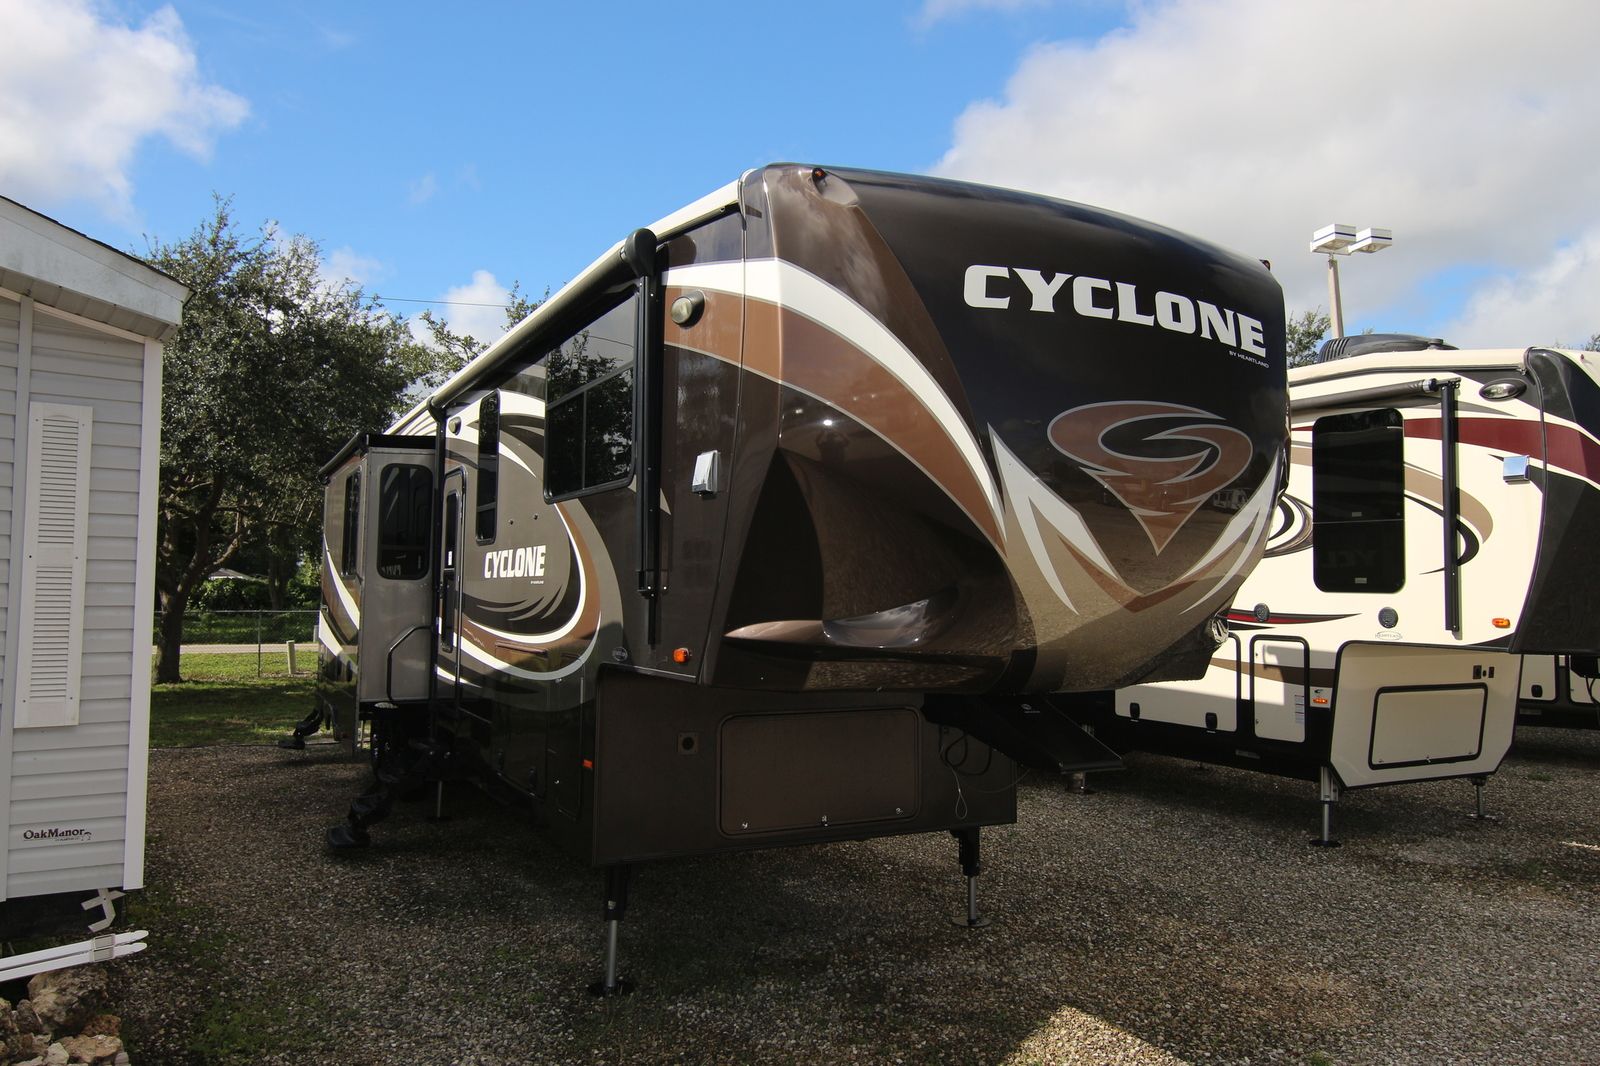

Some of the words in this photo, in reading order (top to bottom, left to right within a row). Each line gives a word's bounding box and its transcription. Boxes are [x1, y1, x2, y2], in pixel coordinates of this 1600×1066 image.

[963, 264, 1267, 358] CYCLONE
[1237, 353, 1270, 369] HEARTLAND
[484, 545, 546, 579] CYCLONE
